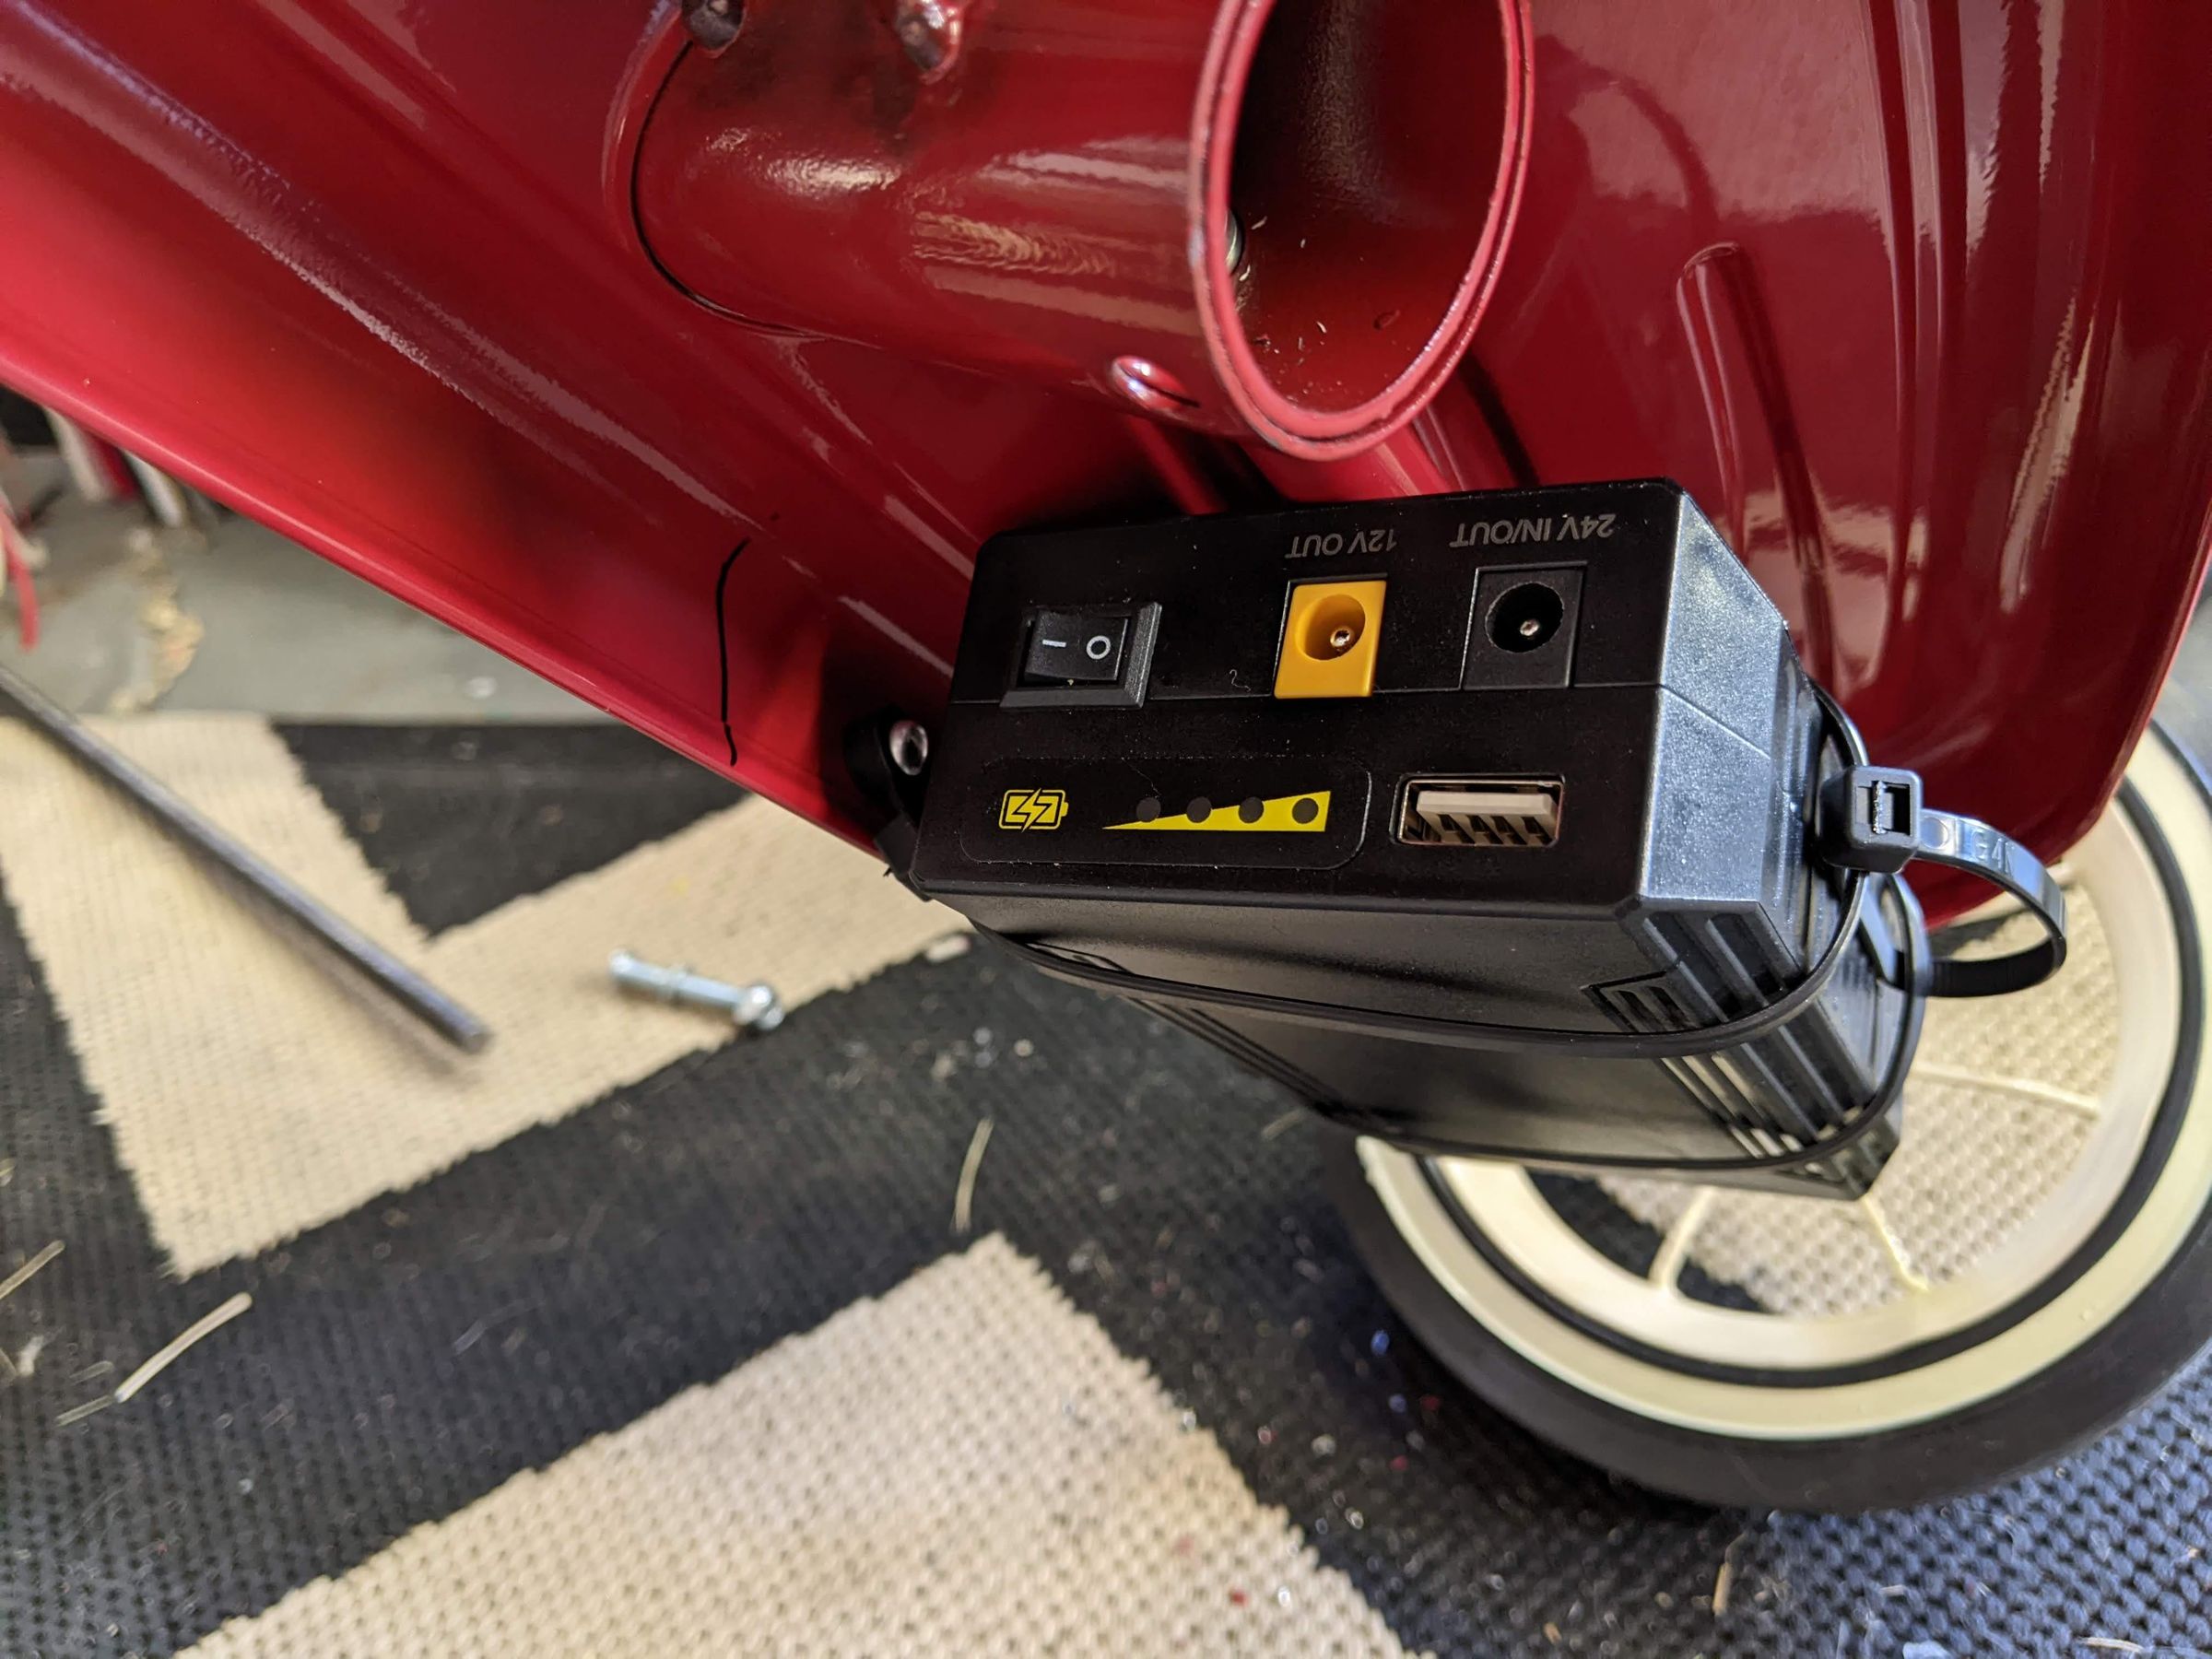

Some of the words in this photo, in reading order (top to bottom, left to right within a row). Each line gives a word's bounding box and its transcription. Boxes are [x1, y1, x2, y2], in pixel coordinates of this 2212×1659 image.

[1449, 517, 1552, 547] IN/OUT
[1556, 513, 1616, 541] 24V
[1284, 533, 1344, 559] OUT
[1347, 528, 1397, 554] 12V
